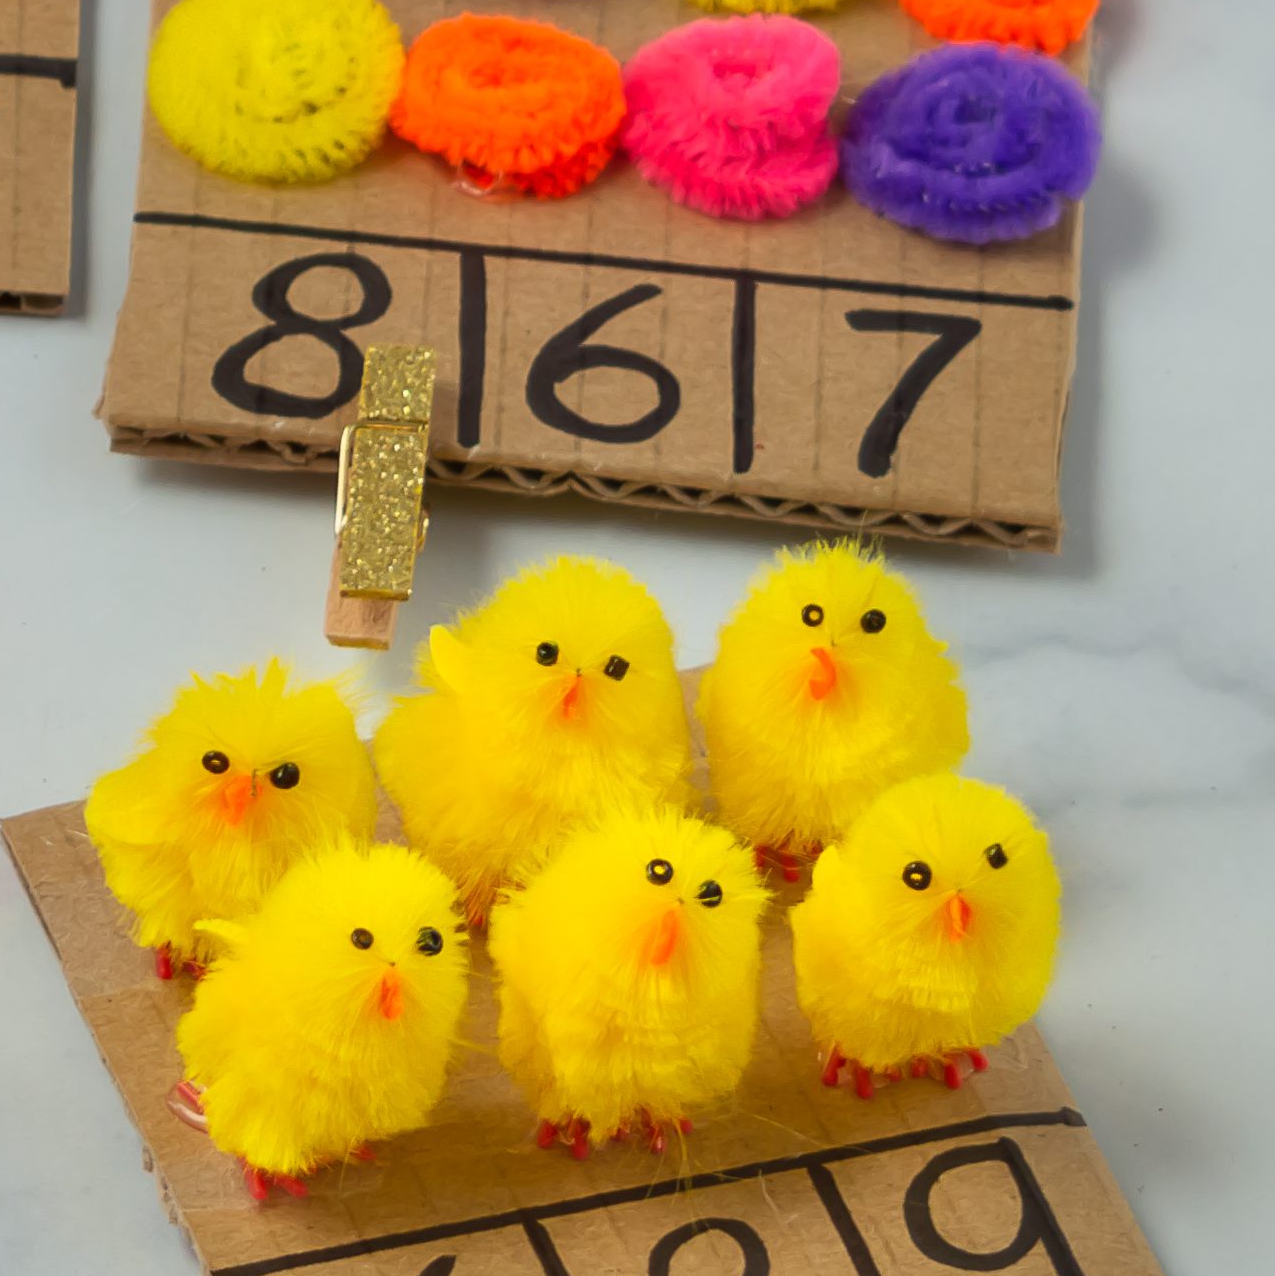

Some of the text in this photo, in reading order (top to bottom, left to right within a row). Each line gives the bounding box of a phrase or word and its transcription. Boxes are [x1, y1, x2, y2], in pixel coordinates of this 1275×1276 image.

[211, 252, 982, 477] 8 6 7
